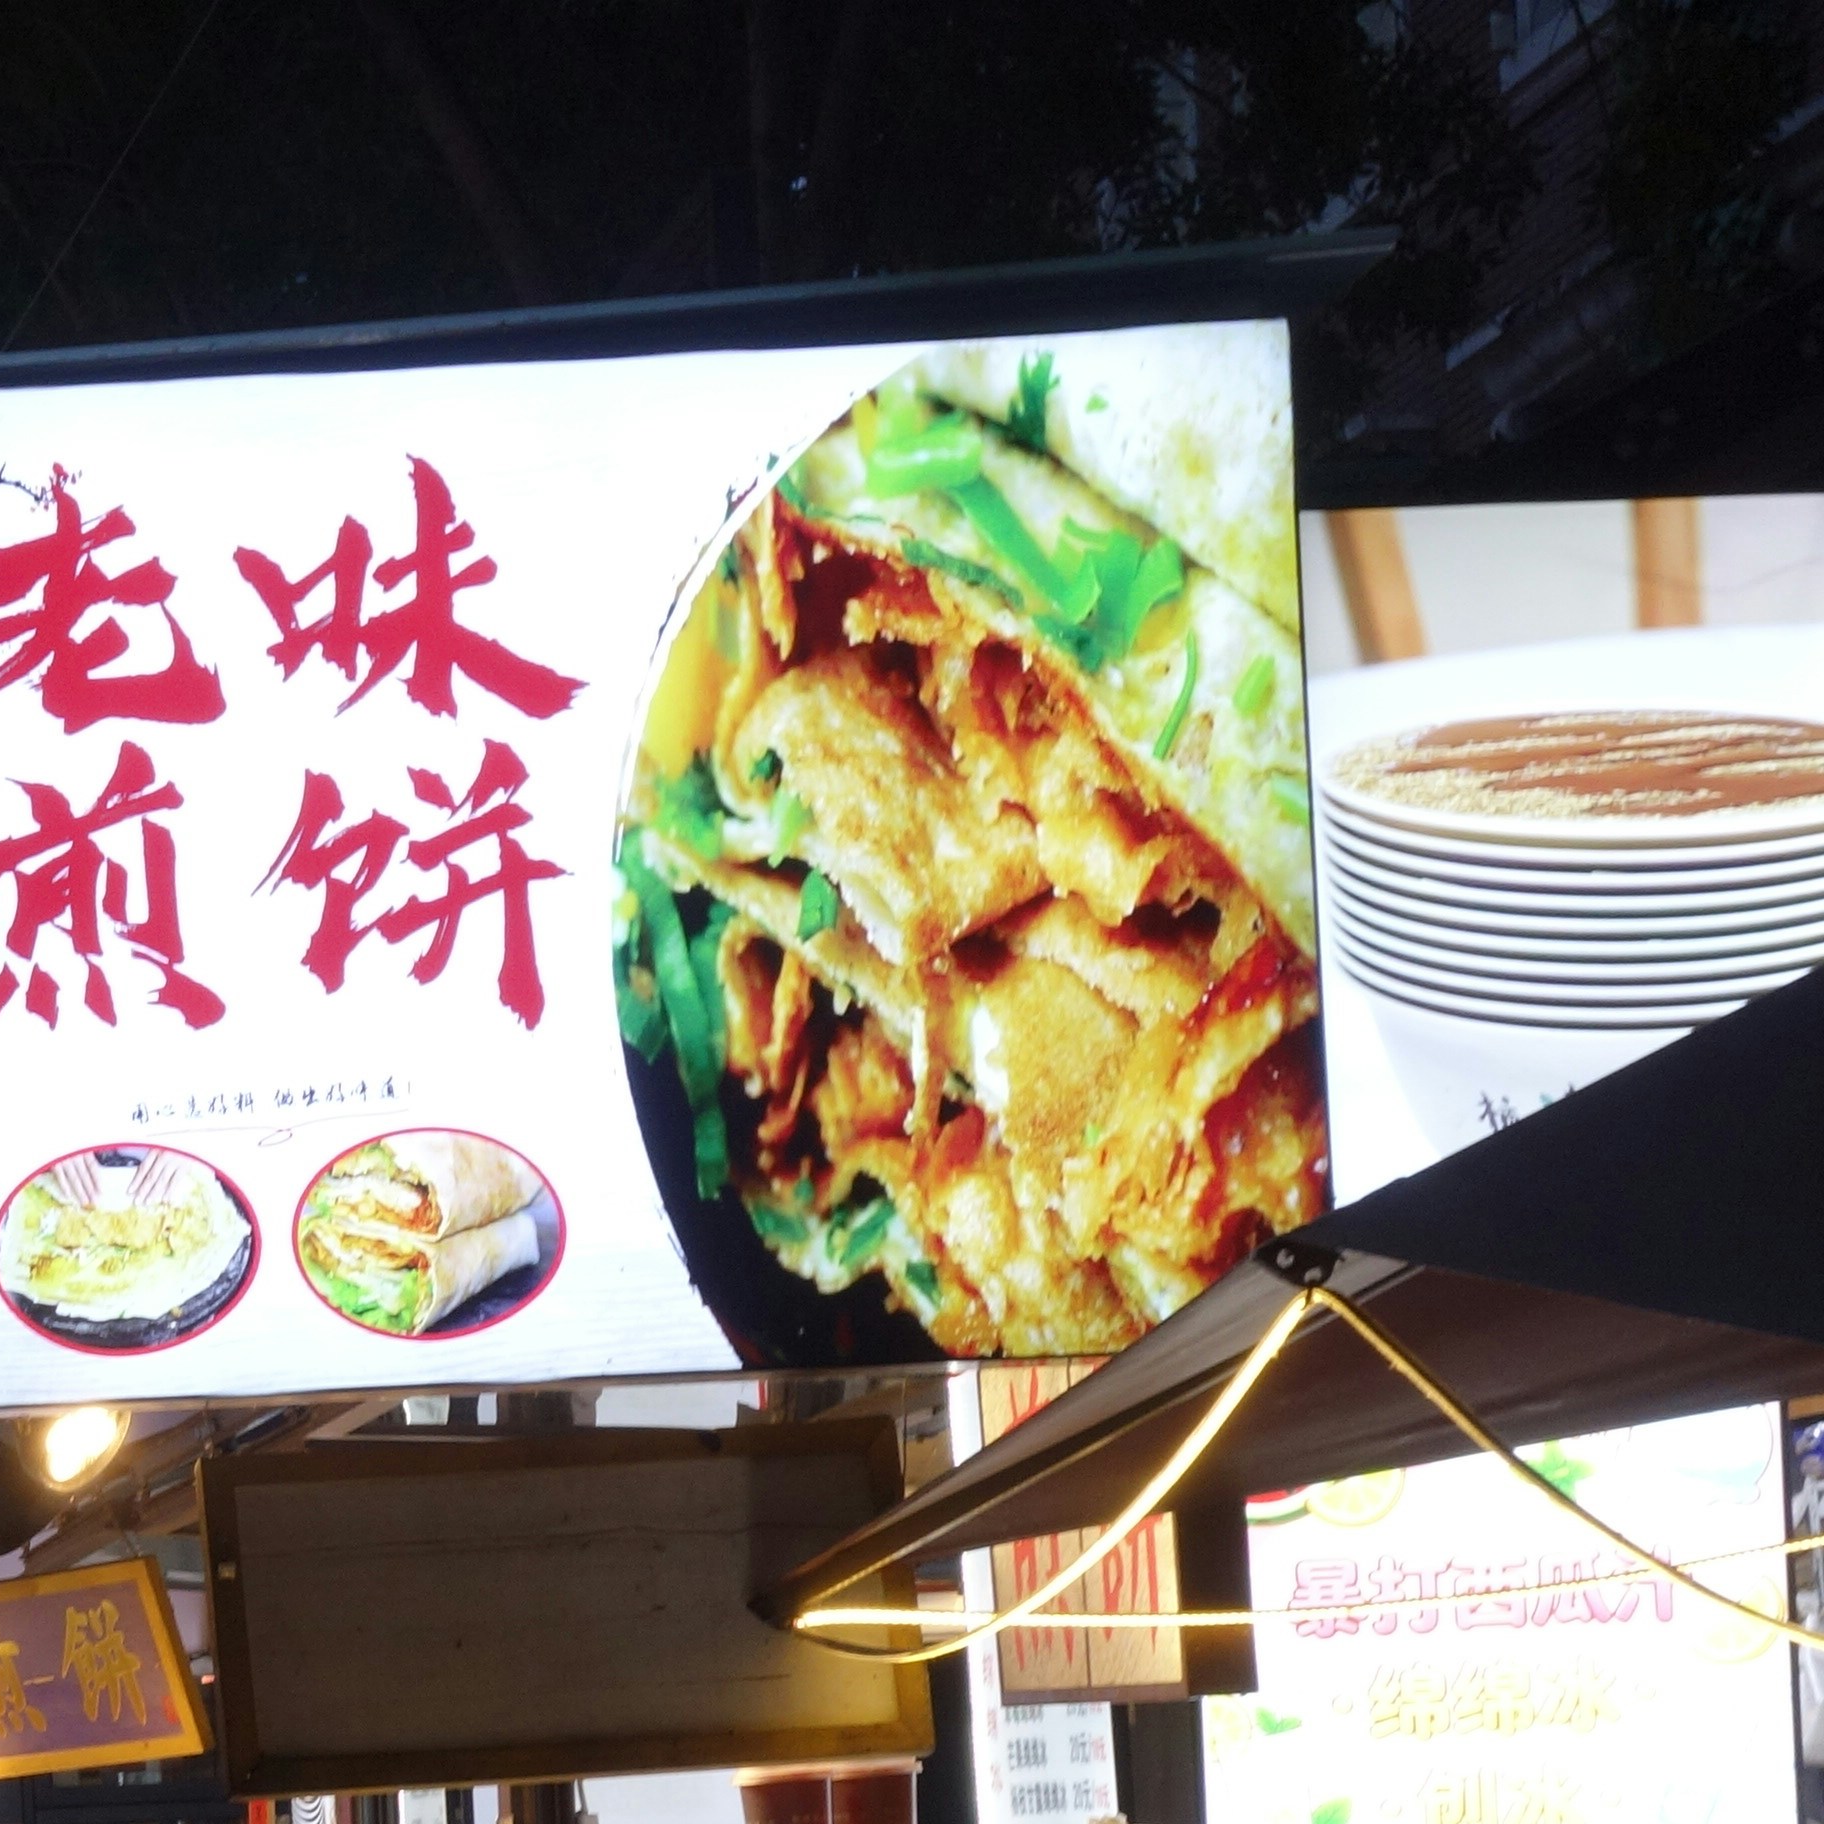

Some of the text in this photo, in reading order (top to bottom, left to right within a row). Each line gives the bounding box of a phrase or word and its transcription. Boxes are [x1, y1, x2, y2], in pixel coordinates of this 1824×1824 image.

[1288, 1545, 1678, 1639] 暴打西瓜汁
[1367, 1656, 1622, 1741] 绵绵冰
